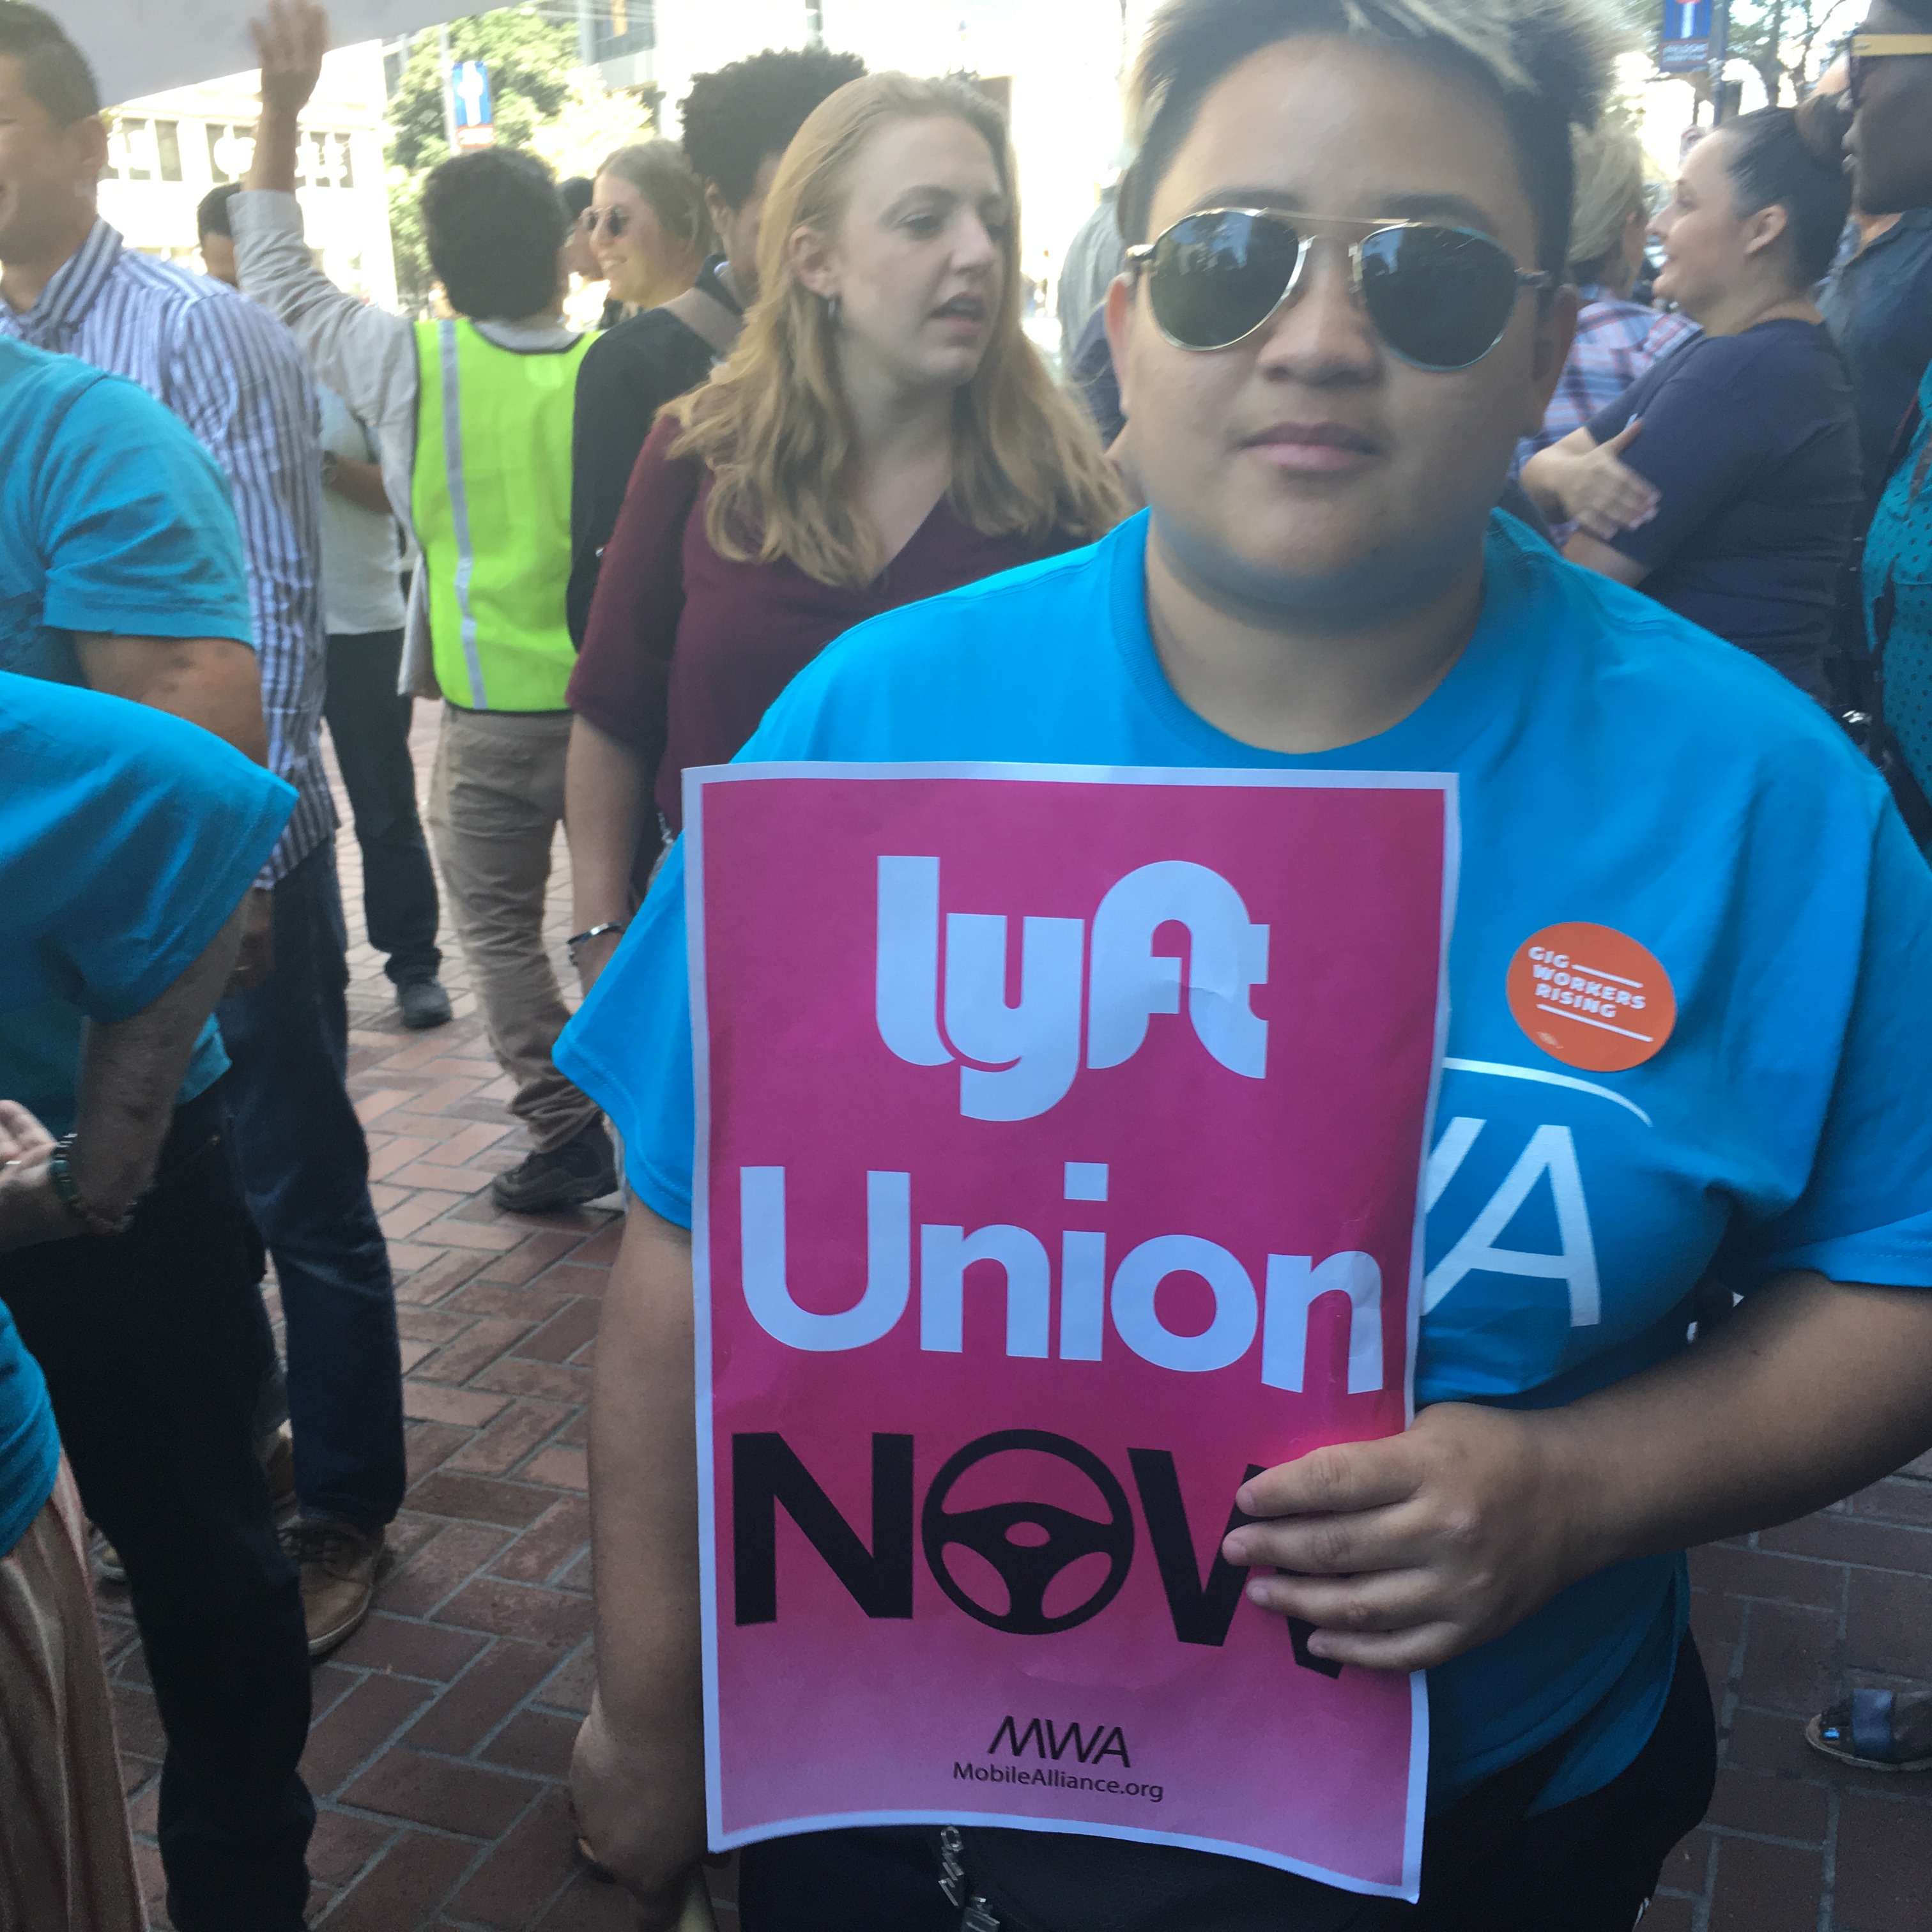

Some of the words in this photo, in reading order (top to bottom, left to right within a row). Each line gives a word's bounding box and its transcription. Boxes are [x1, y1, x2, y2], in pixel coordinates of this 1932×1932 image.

[1528, 946, 1570, 969] GIG
[876, 855, 1270, 1122] lyft
[1533, 964, 1646, 1009] WORKERS
[1535, 983, 1617, 1018] RISING
[739, 1161, 1384, 1395] Union
[987, 1715, 1131, 1768] MWA
[953, 1761, 1164, 1802] MobileAlliance.org
